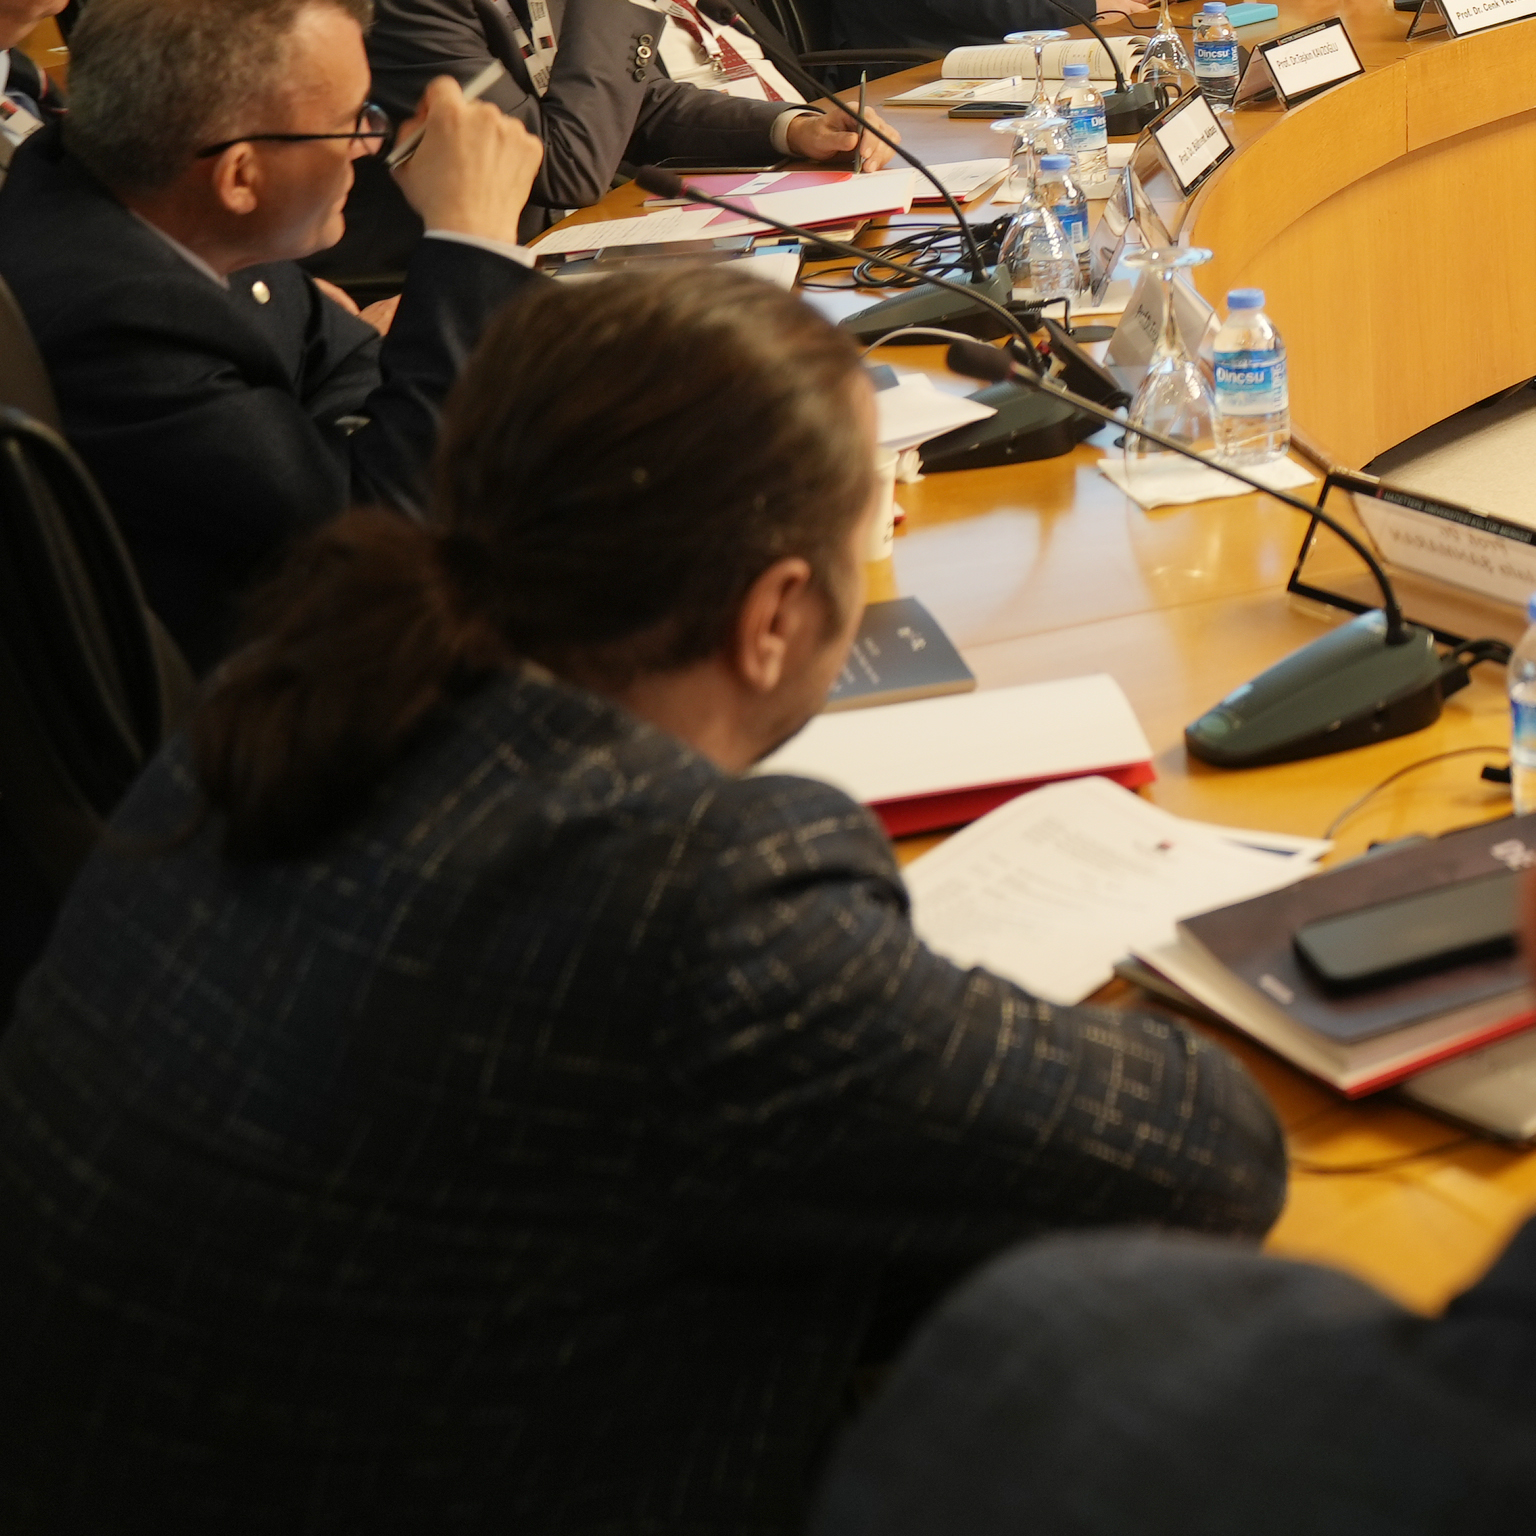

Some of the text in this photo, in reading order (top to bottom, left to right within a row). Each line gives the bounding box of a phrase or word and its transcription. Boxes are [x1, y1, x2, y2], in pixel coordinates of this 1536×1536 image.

[1456, 10, 1471, 20] Prof.
[1473, 6, 1482, 15] Dr.
[1483, 0, 1500, 12] Cenk
